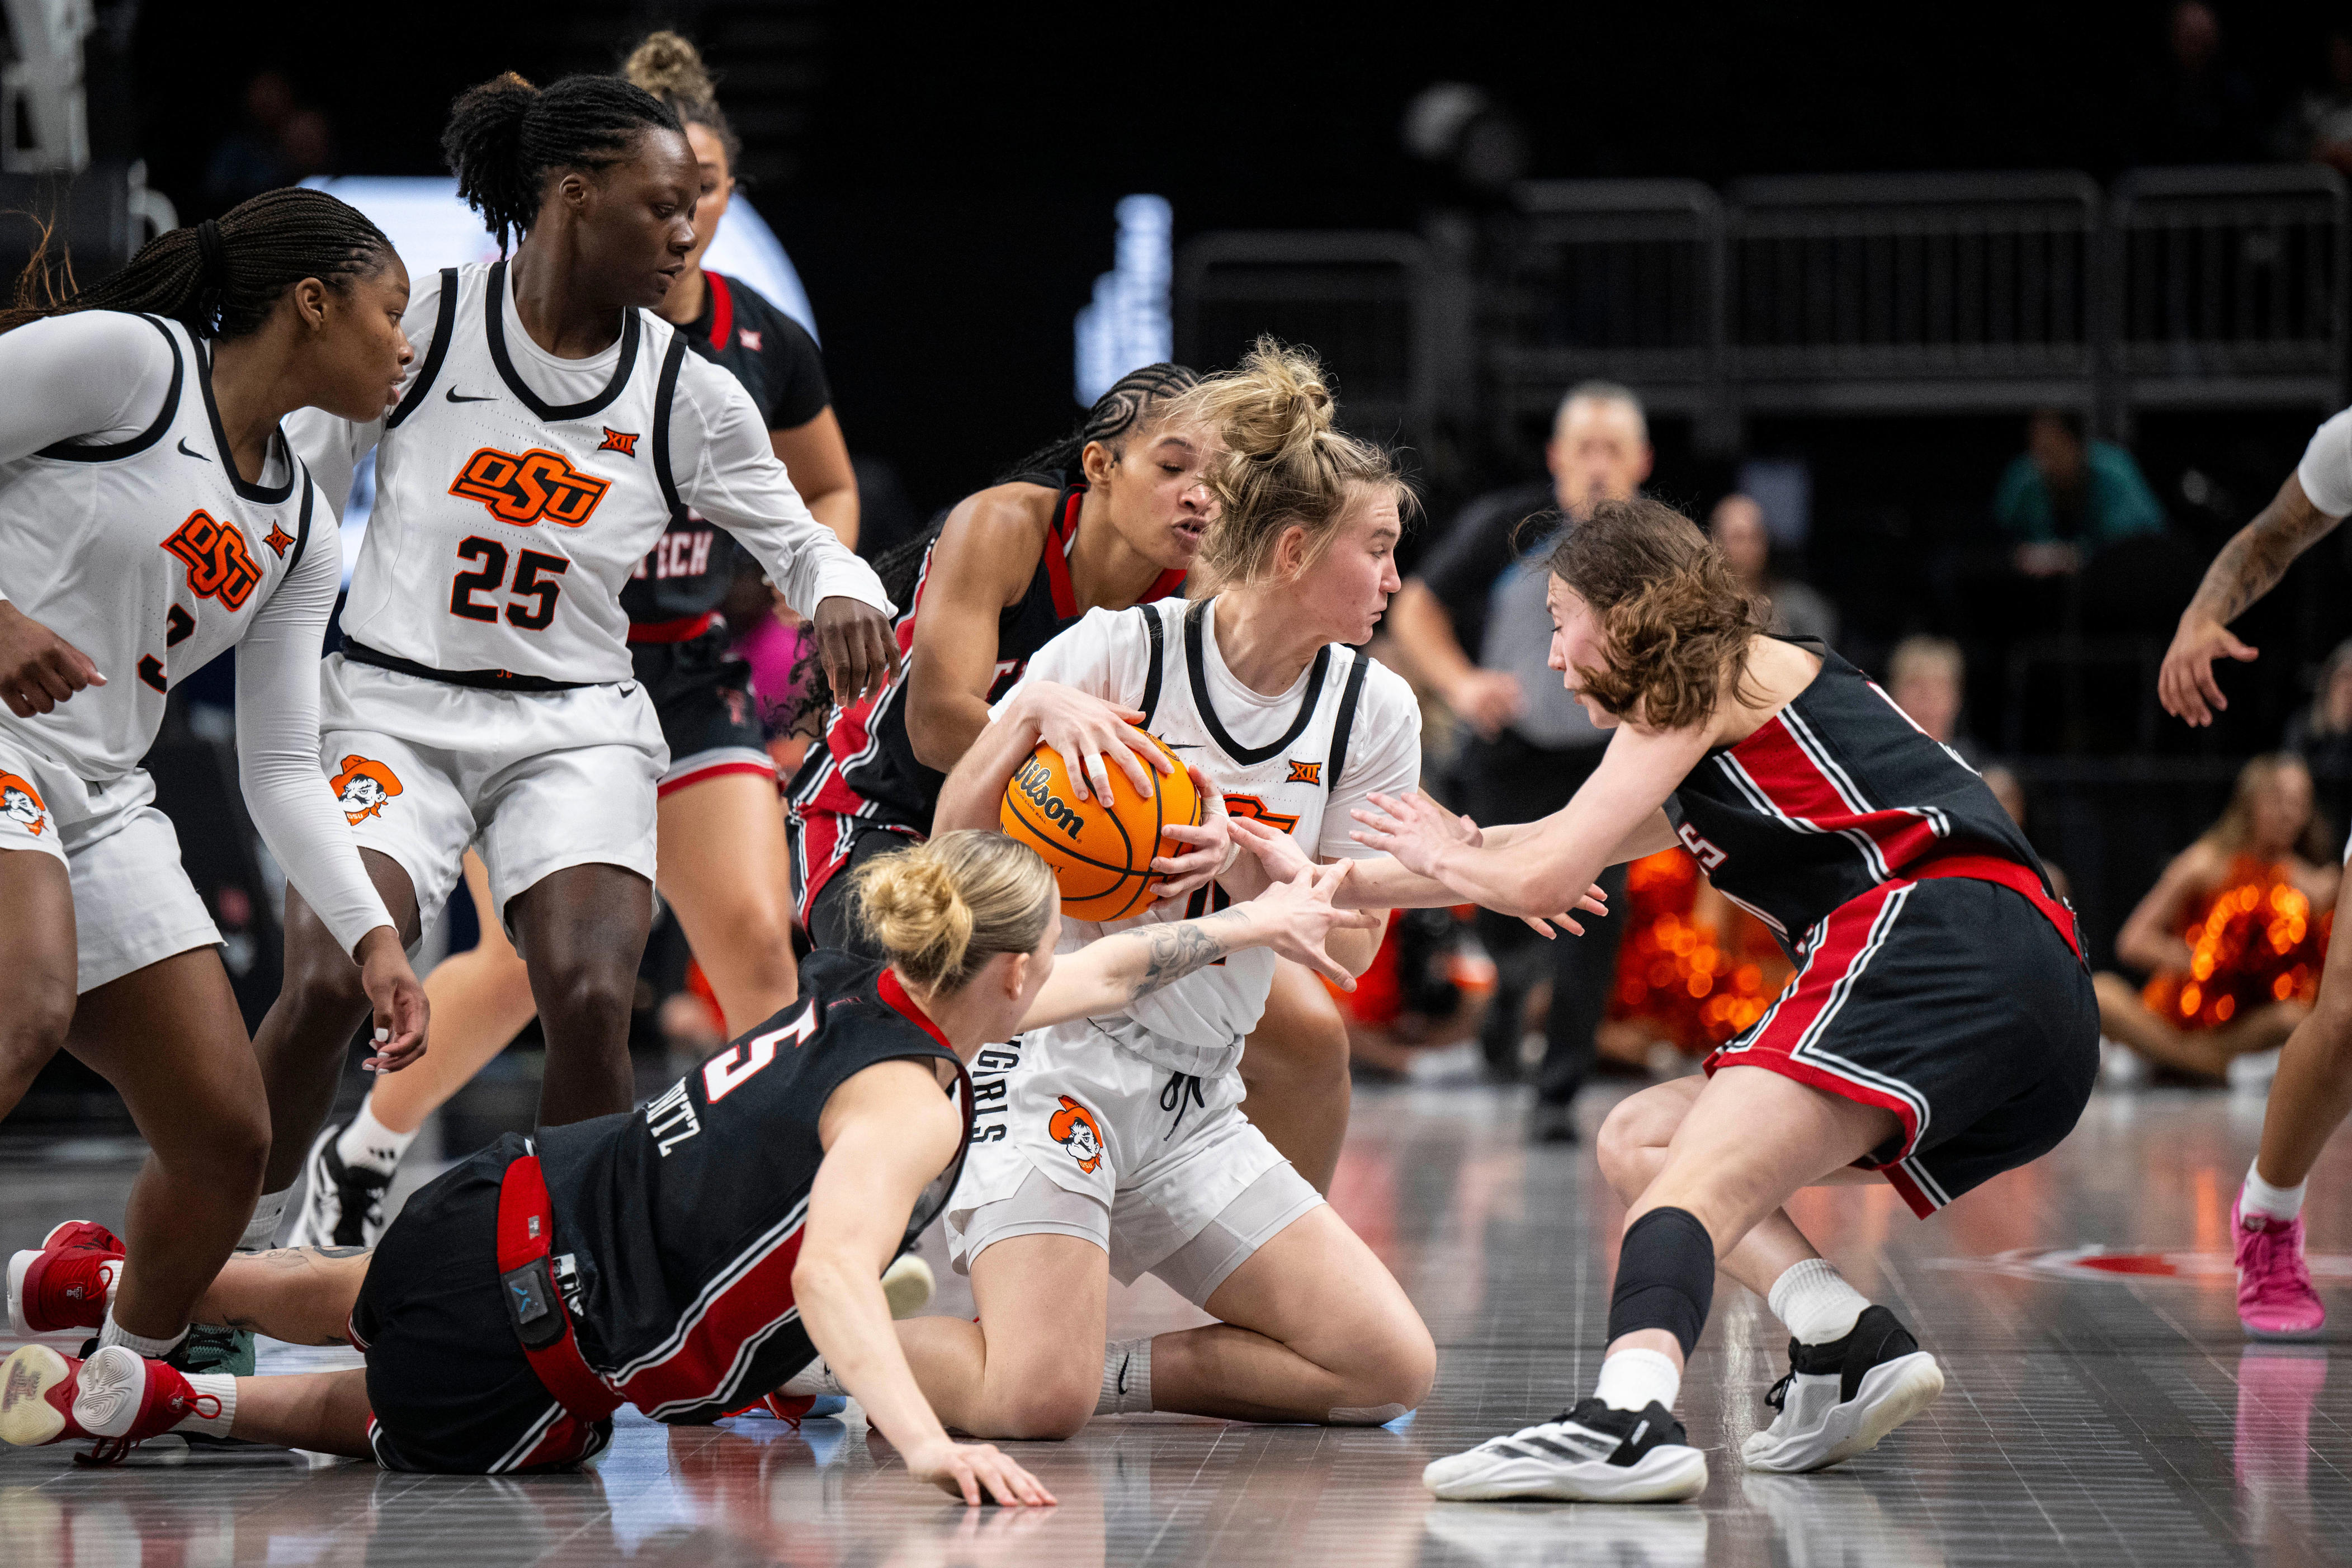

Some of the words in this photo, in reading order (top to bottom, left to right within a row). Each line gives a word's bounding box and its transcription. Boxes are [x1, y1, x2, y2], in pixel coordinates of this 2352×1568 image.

[448, 447, 612, 527] OSU
[597, 426, 640, 459] XII
[159, 508, 263, 612] OSU
[450, 535, 570, 631] 25
[1286, 759, 1322, 787] XII
[702, 997, 819, 1104] 5
[969, 1032, 1024, 1144] GIRLS
